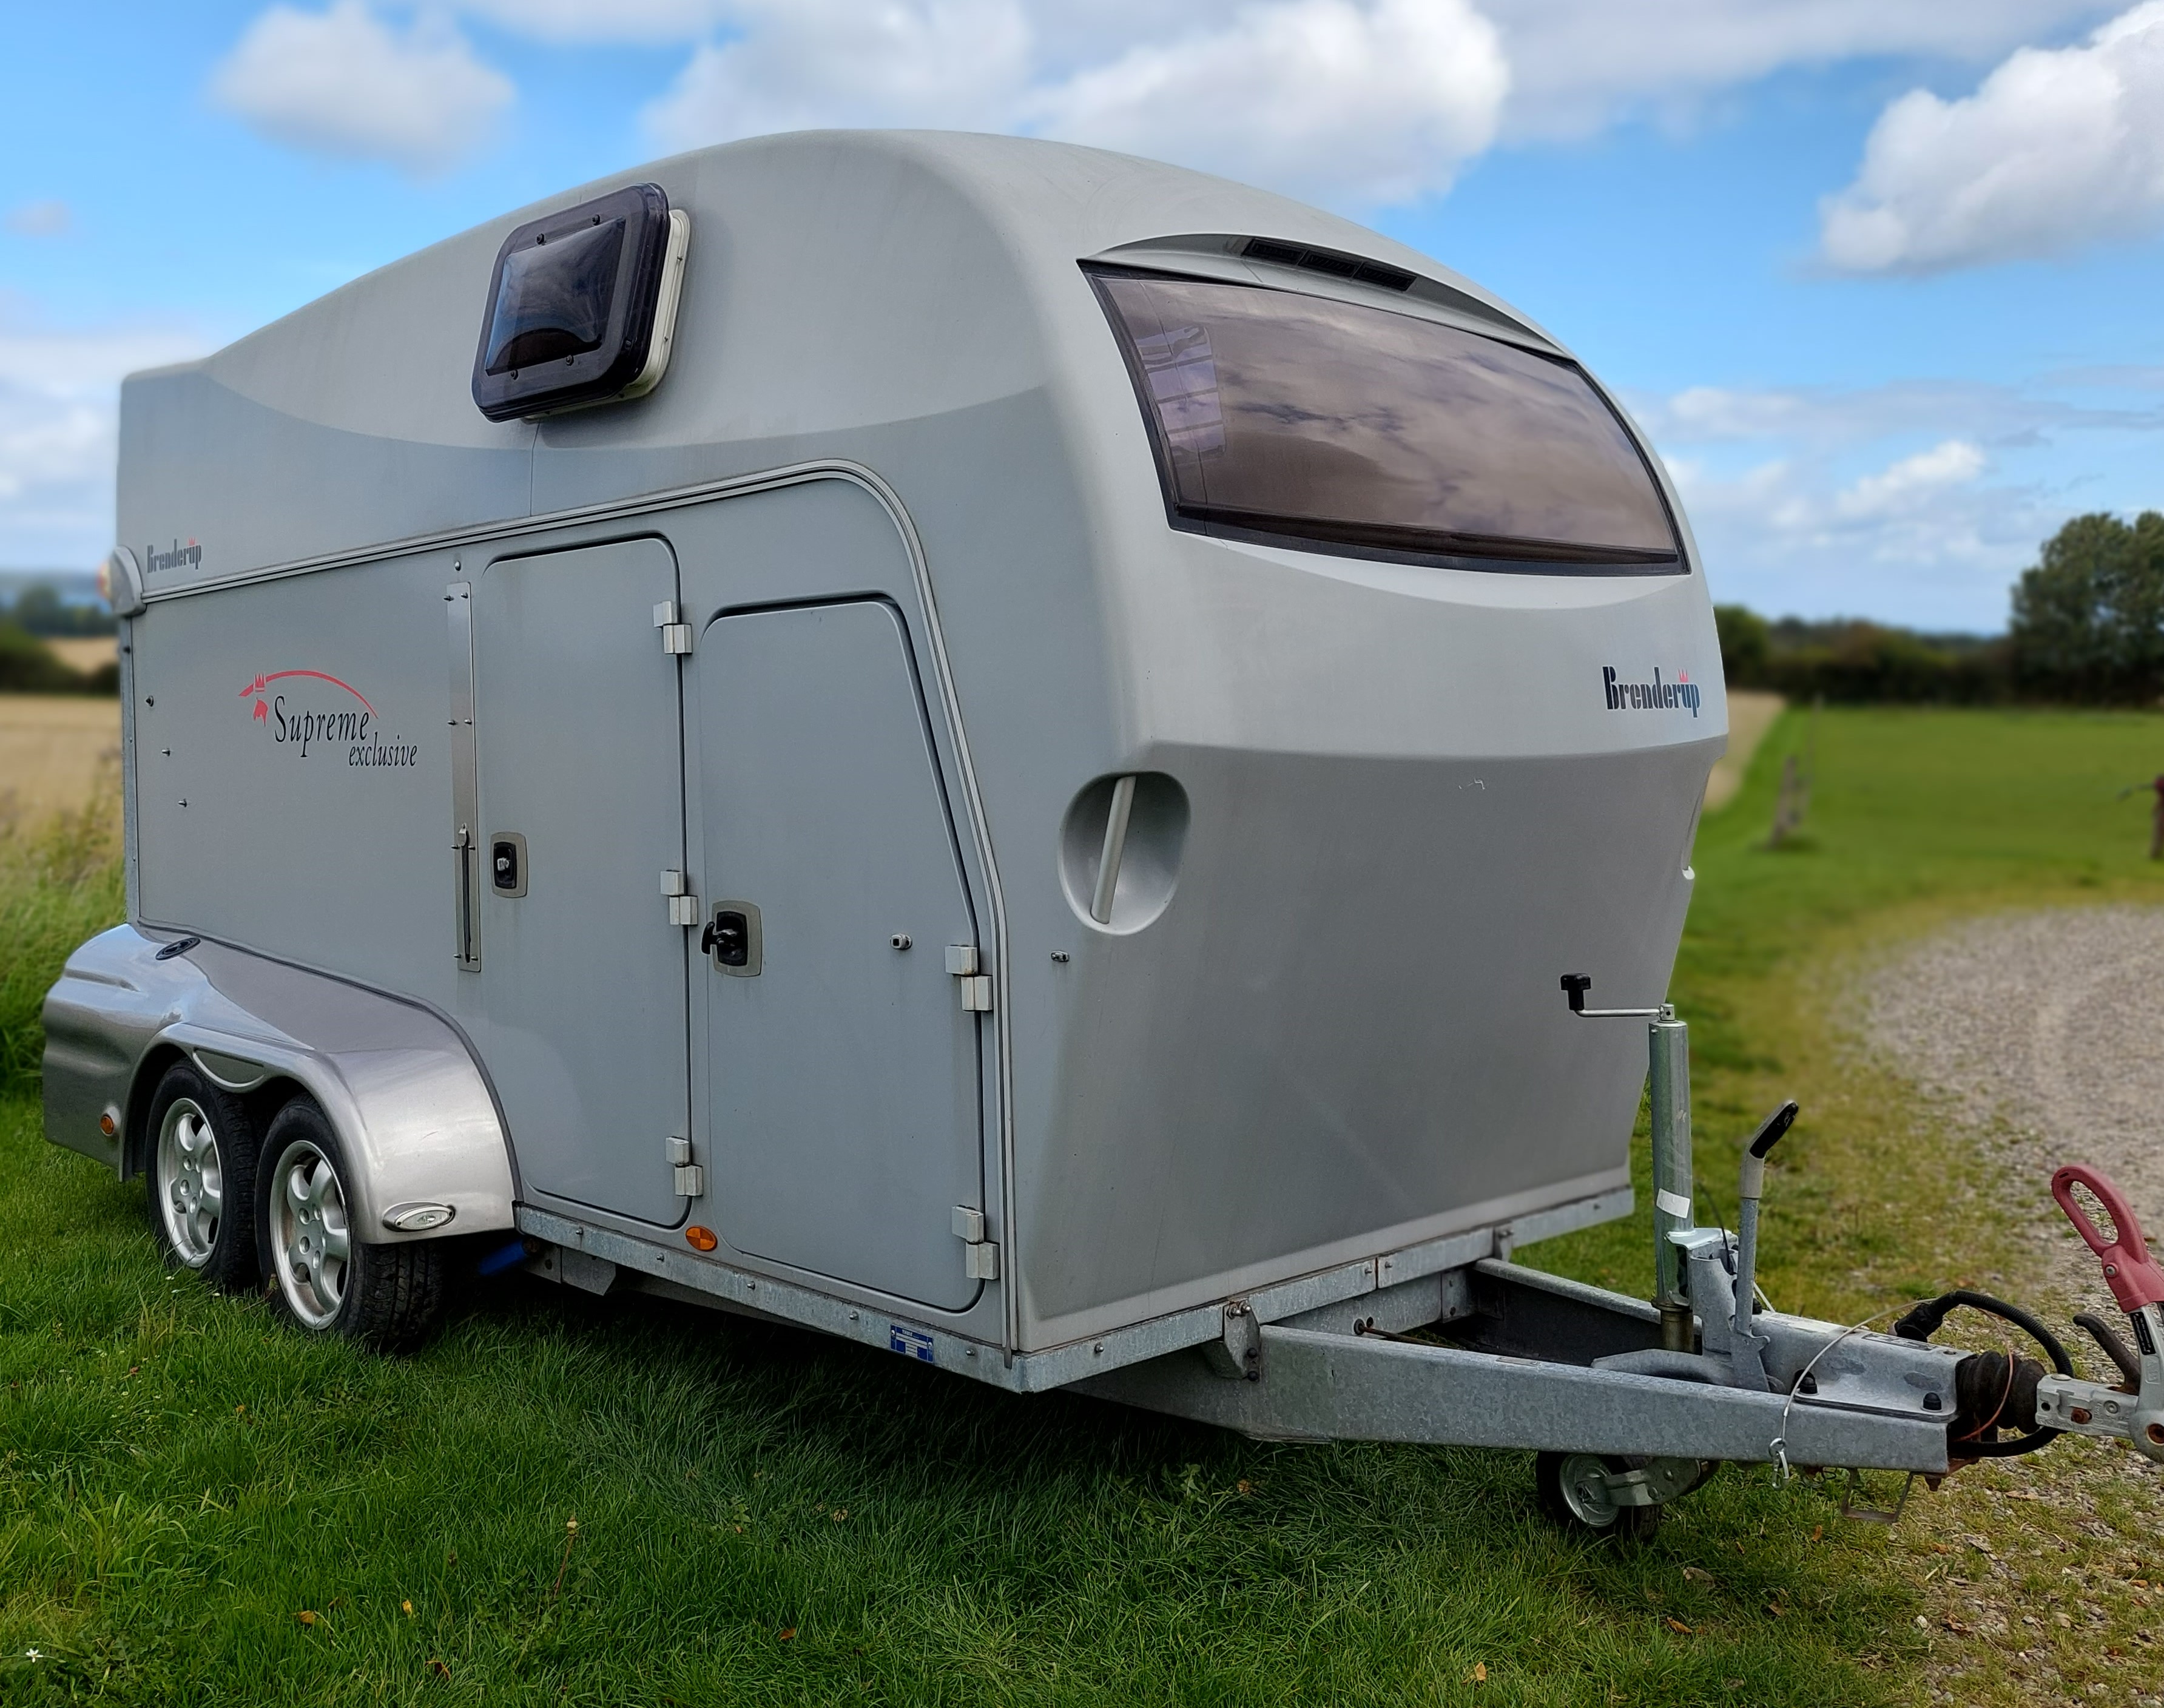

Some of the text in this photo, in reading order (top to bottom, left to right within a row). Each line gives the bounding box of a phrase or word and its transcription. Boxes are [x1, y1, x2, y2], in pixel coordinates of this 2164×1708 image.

[147, 538, 202, 573] Brenderup
[1602, 666, 1701, 718] Brenderup
[274, 695, 369, 758] Supreme
[348, 731, 417, 767] exclusive
